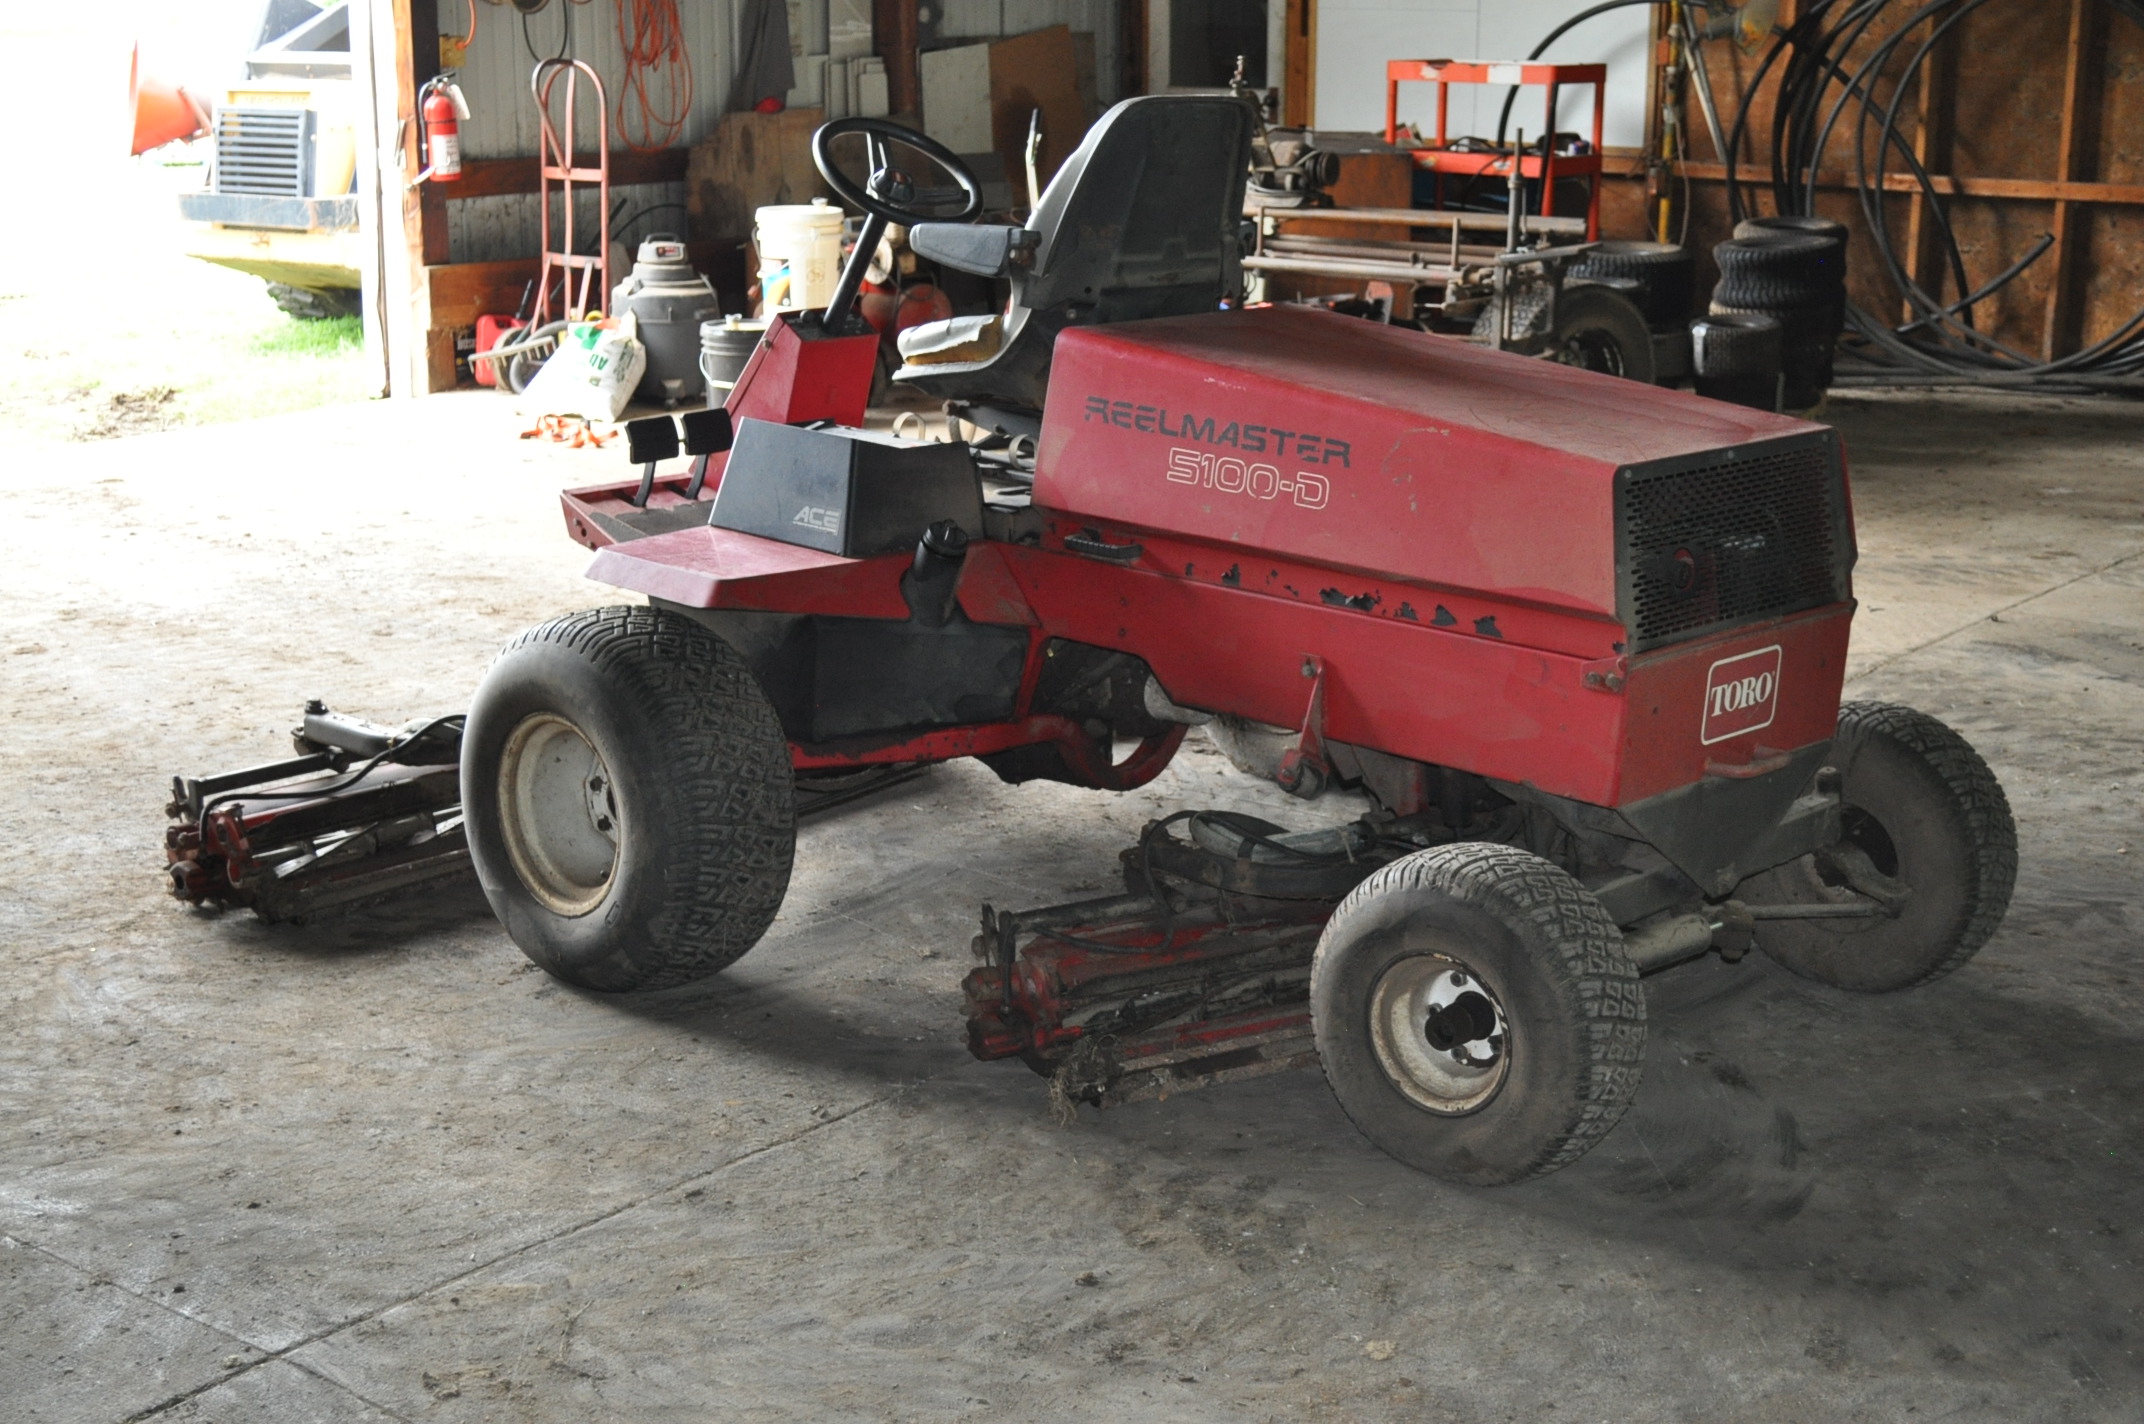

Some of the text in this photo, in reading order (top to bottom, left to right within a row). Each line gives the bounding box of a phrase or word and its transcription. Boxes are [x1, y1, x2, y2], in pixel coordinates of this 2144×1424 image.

[1085, 396, 1351, 468] REELMASTER
[1167, 447, 1330, 510] 5100-D
[793, 505, 841, 528] ACE
[1710, 672, 1772, 717] TORO
